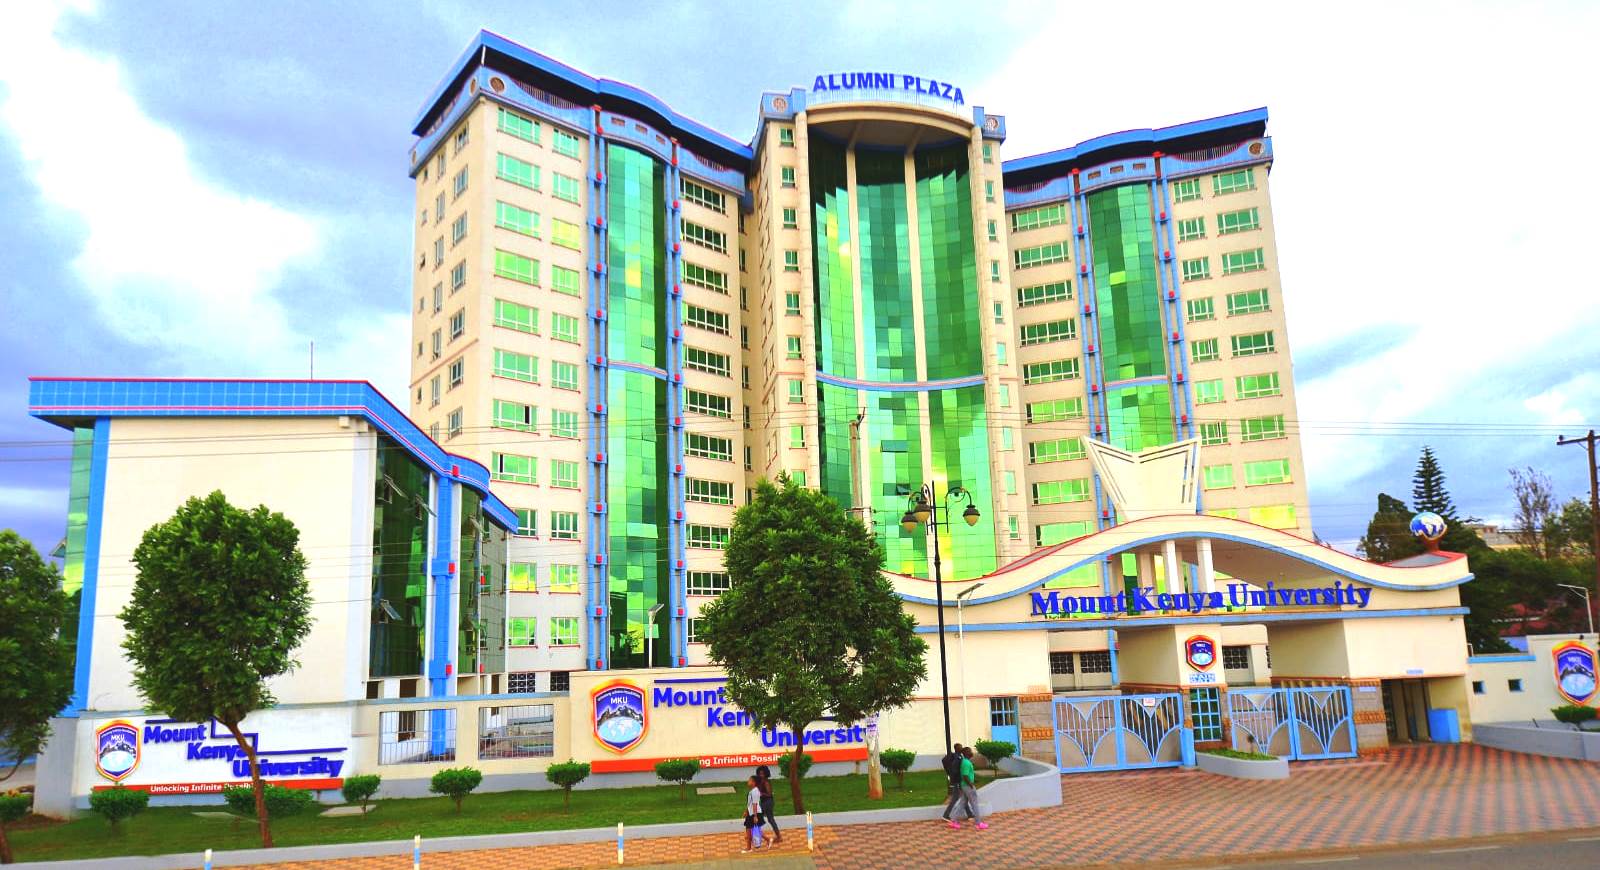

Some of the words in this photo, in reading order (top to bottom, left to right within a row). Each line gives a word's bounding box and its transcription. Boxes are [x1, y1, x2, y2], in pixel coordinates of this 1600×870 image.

[813, 72, 894, 92] ALUMNI
[903, 75, 965, 105] PLAZA
[1029, 590, 1129, 616] Mount
[1131, 586, 1226, 613] Kenya
[1227, 580, 1373, 608] University
[611, 696, 627, 704] MKU
[654, 687, 728, 708] Mount
[144, 724, 207, 744] Mount
[761, 724, 867, 748] Universit
[713, 757, 748, 765] Infinite
[150, 784, 190, 793] Unlocking
[191, 783, 222, 791] Infinite
